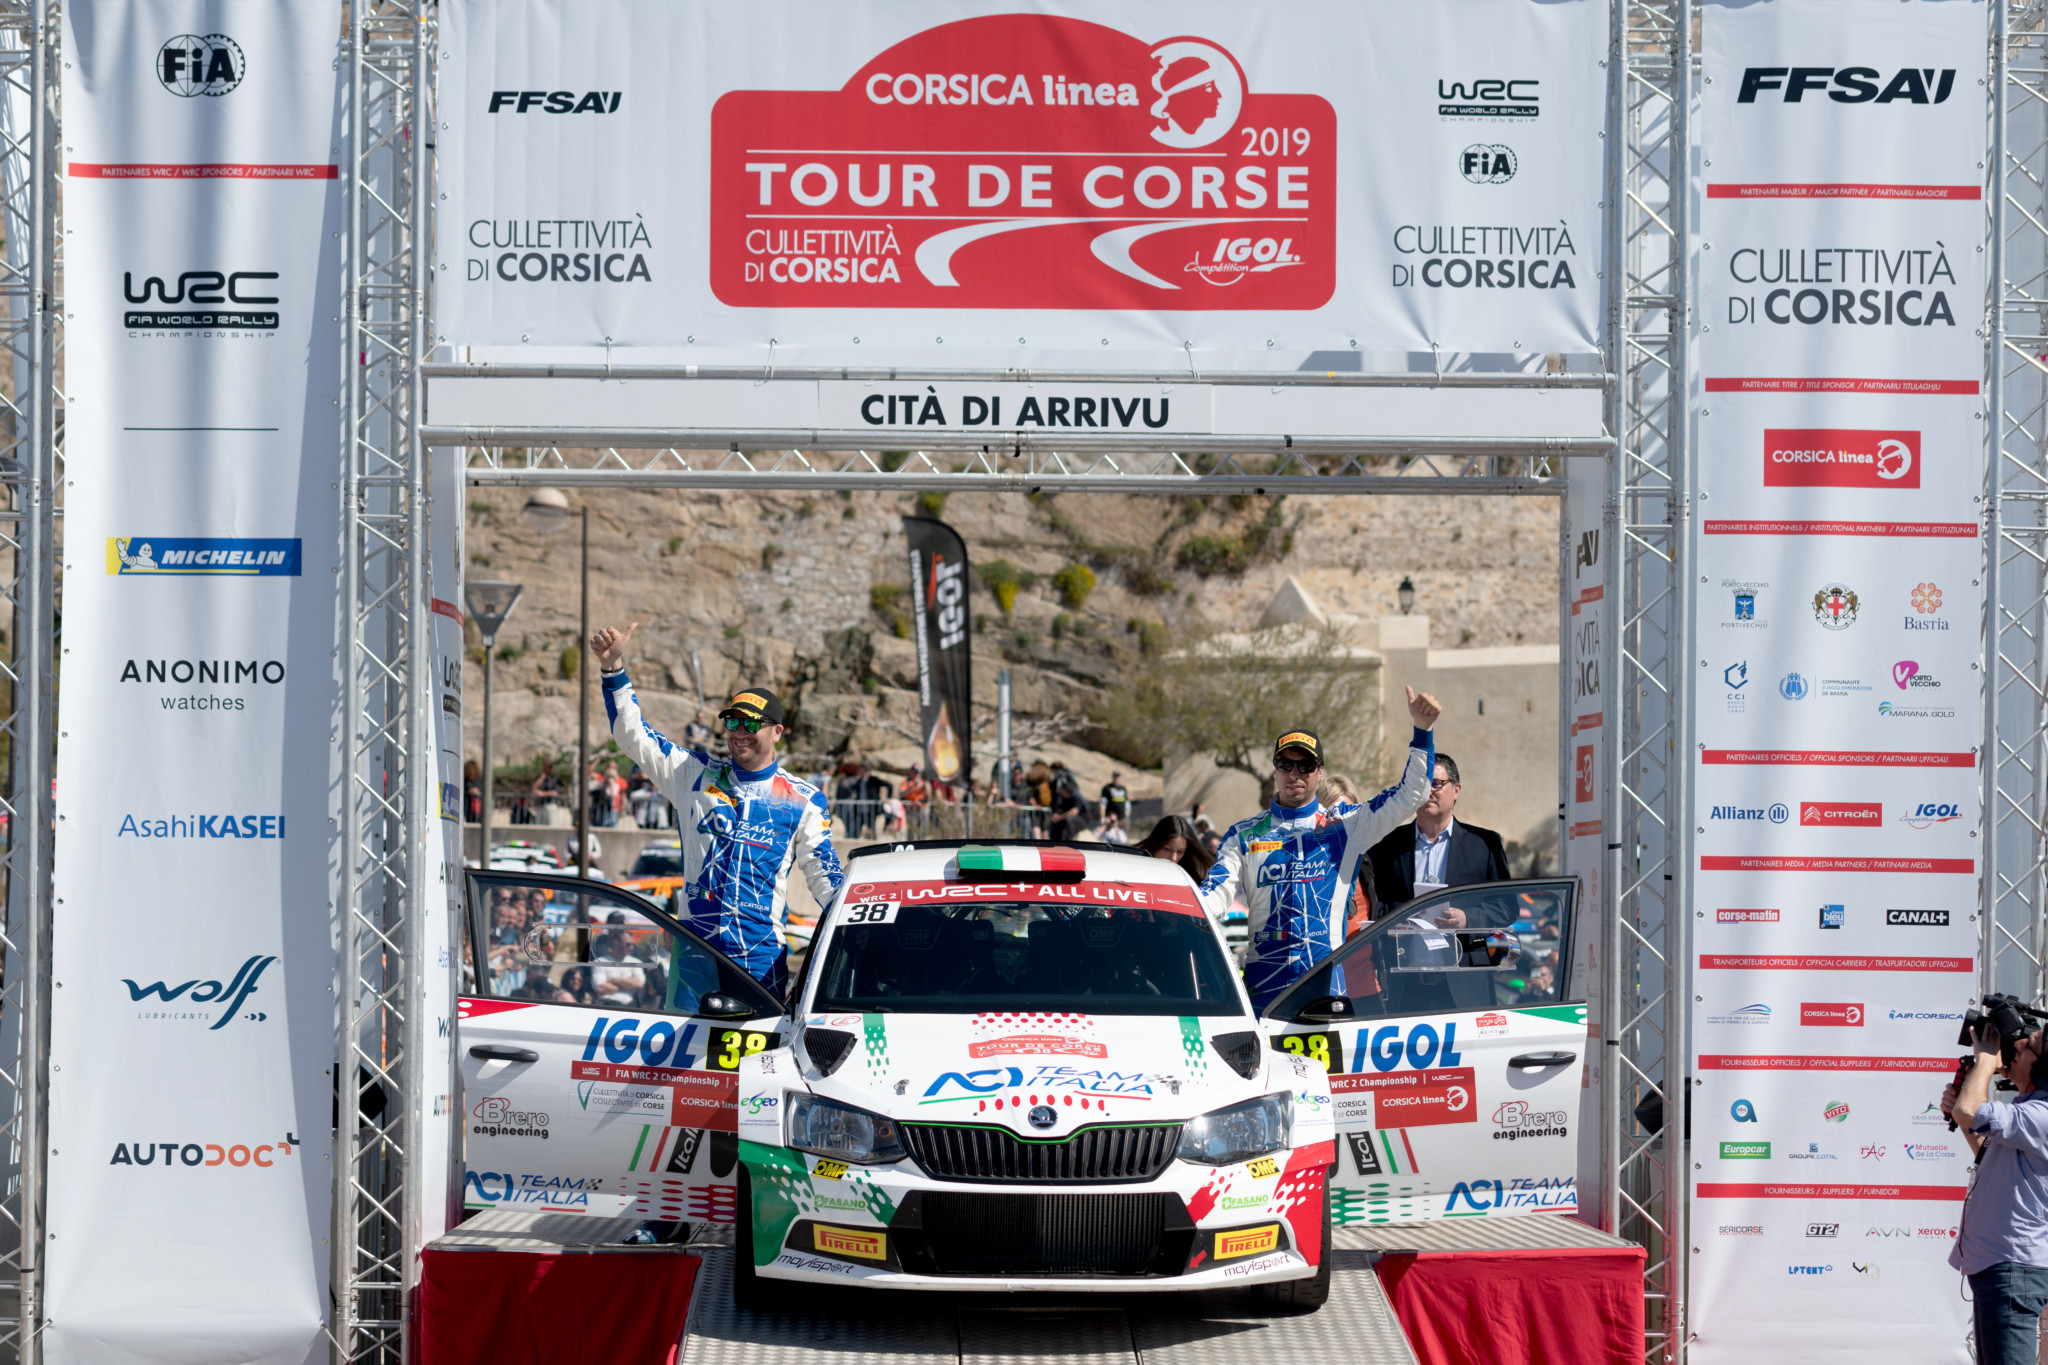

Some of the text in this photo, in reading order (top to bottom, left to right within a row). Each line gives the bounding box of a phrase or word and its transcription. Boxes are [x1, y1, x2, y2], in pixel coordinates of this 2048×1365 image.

[866, 73, 1139, 106] CORSICA linea
[1439, 79, 1539, 101] WRC
[1241, 127, 1310, 157] 2019
[201, 168, 243, 176] SPONSORS
[746, 163, 1309, 209] TOUR DE CORSE
[469, 212, 652, 249] CULLETTIVITÀ
[1394, 219, 1576, 255] CULLETTIVITÀ
[746, 224, 901, 255] CULLETTIVITÀ
[468, 252, 652, 282] DI CORSICA
[745, 257, 901, 283] DI CORSICA
[1730, 240, 1956, 285] CULLETTIVITÀ
[1393, 259, 1576, 289] DI CORSICA
[124, 271, 279, 304] WRC
[1729, 289, 1956, 326] DI CORSICA
[129, 315, 275, 325] FIA WORLD RALLY
[861, 385, 1168, 428] CITÀ DI ARRIVU
[1772, 450, 1874, 464] CORSICA linea
[162, 551, 286, 565] MICHELIN
[120, 659, 285, 684] ANONIMO
[161, 695, 244, 710] watches
[1711, 806, 1765, 820] Allianz
[736, 821, 772, 835] TEAM
[1286, 870, 1325, 878] ITALIA
[860, 894, 886, 903] WRC
[1038, 885, 1147, 903] ALL LIVE
[848, 903, 889, 923] 38
[1719, 910, 1778, 921] corse-matin
[1888, 912, 1947, 923] CANAL+
[582, 1017, 698, 1068] IGOL
[1351, 1022, 1461, 1073] IGOL
[616, 1070, 629, 1078] FIA
[632, 1071, 650, 1079] WRC
[661, 1073, 719, 1086] Championship
[1035, 1066, 1145, 1082] TEAM
[1331, 1080, 1349, 1088] WRC
[1359, 1075, 1417, 1087] Championship
[1027, 1076, 1154, 1095] ITALIA
[636, 1092, 665, 1100] CORSICA
[681, 1097, 719, 1108] CORSICA
[1338, 1100, 1367, 1108] CORSICA
[1383, 1096, 1445, 1107] CORSICA linea
[482, 1097, 549, 1126] Brero
[643, 1102, 665, 1110] CORSE
[1501, 1101, 1567, 1128] Brero
[474, 1124, 548, 1139] engineering
[1493, 1126, 1567, 1140] engineering
[109, 1143, 274, 1168] AUTODOC
[1724, 1145, 1766, 1155] Europcar
[814, 1161, 848, 1176] OMP
[1250, 1160, 1278, 1176] OMP
[520, 1175, 585, 1189] TEAM
[1510, 1177, 1573, 1190] TEAM
[514, 1189, 588, 1205] ITALIA
[824, 1197, 866, 1208] FASANO
[1232, 1194, 1268, 1206] FASANO
[1503, 1191, 1577, 1207] ITALIA
[1918, 1227, 1946, 1235] xerox
[820, 1230, 878, 1254] PIRELLI
[1221, 1230, 1272, 1254] PIRELLI
